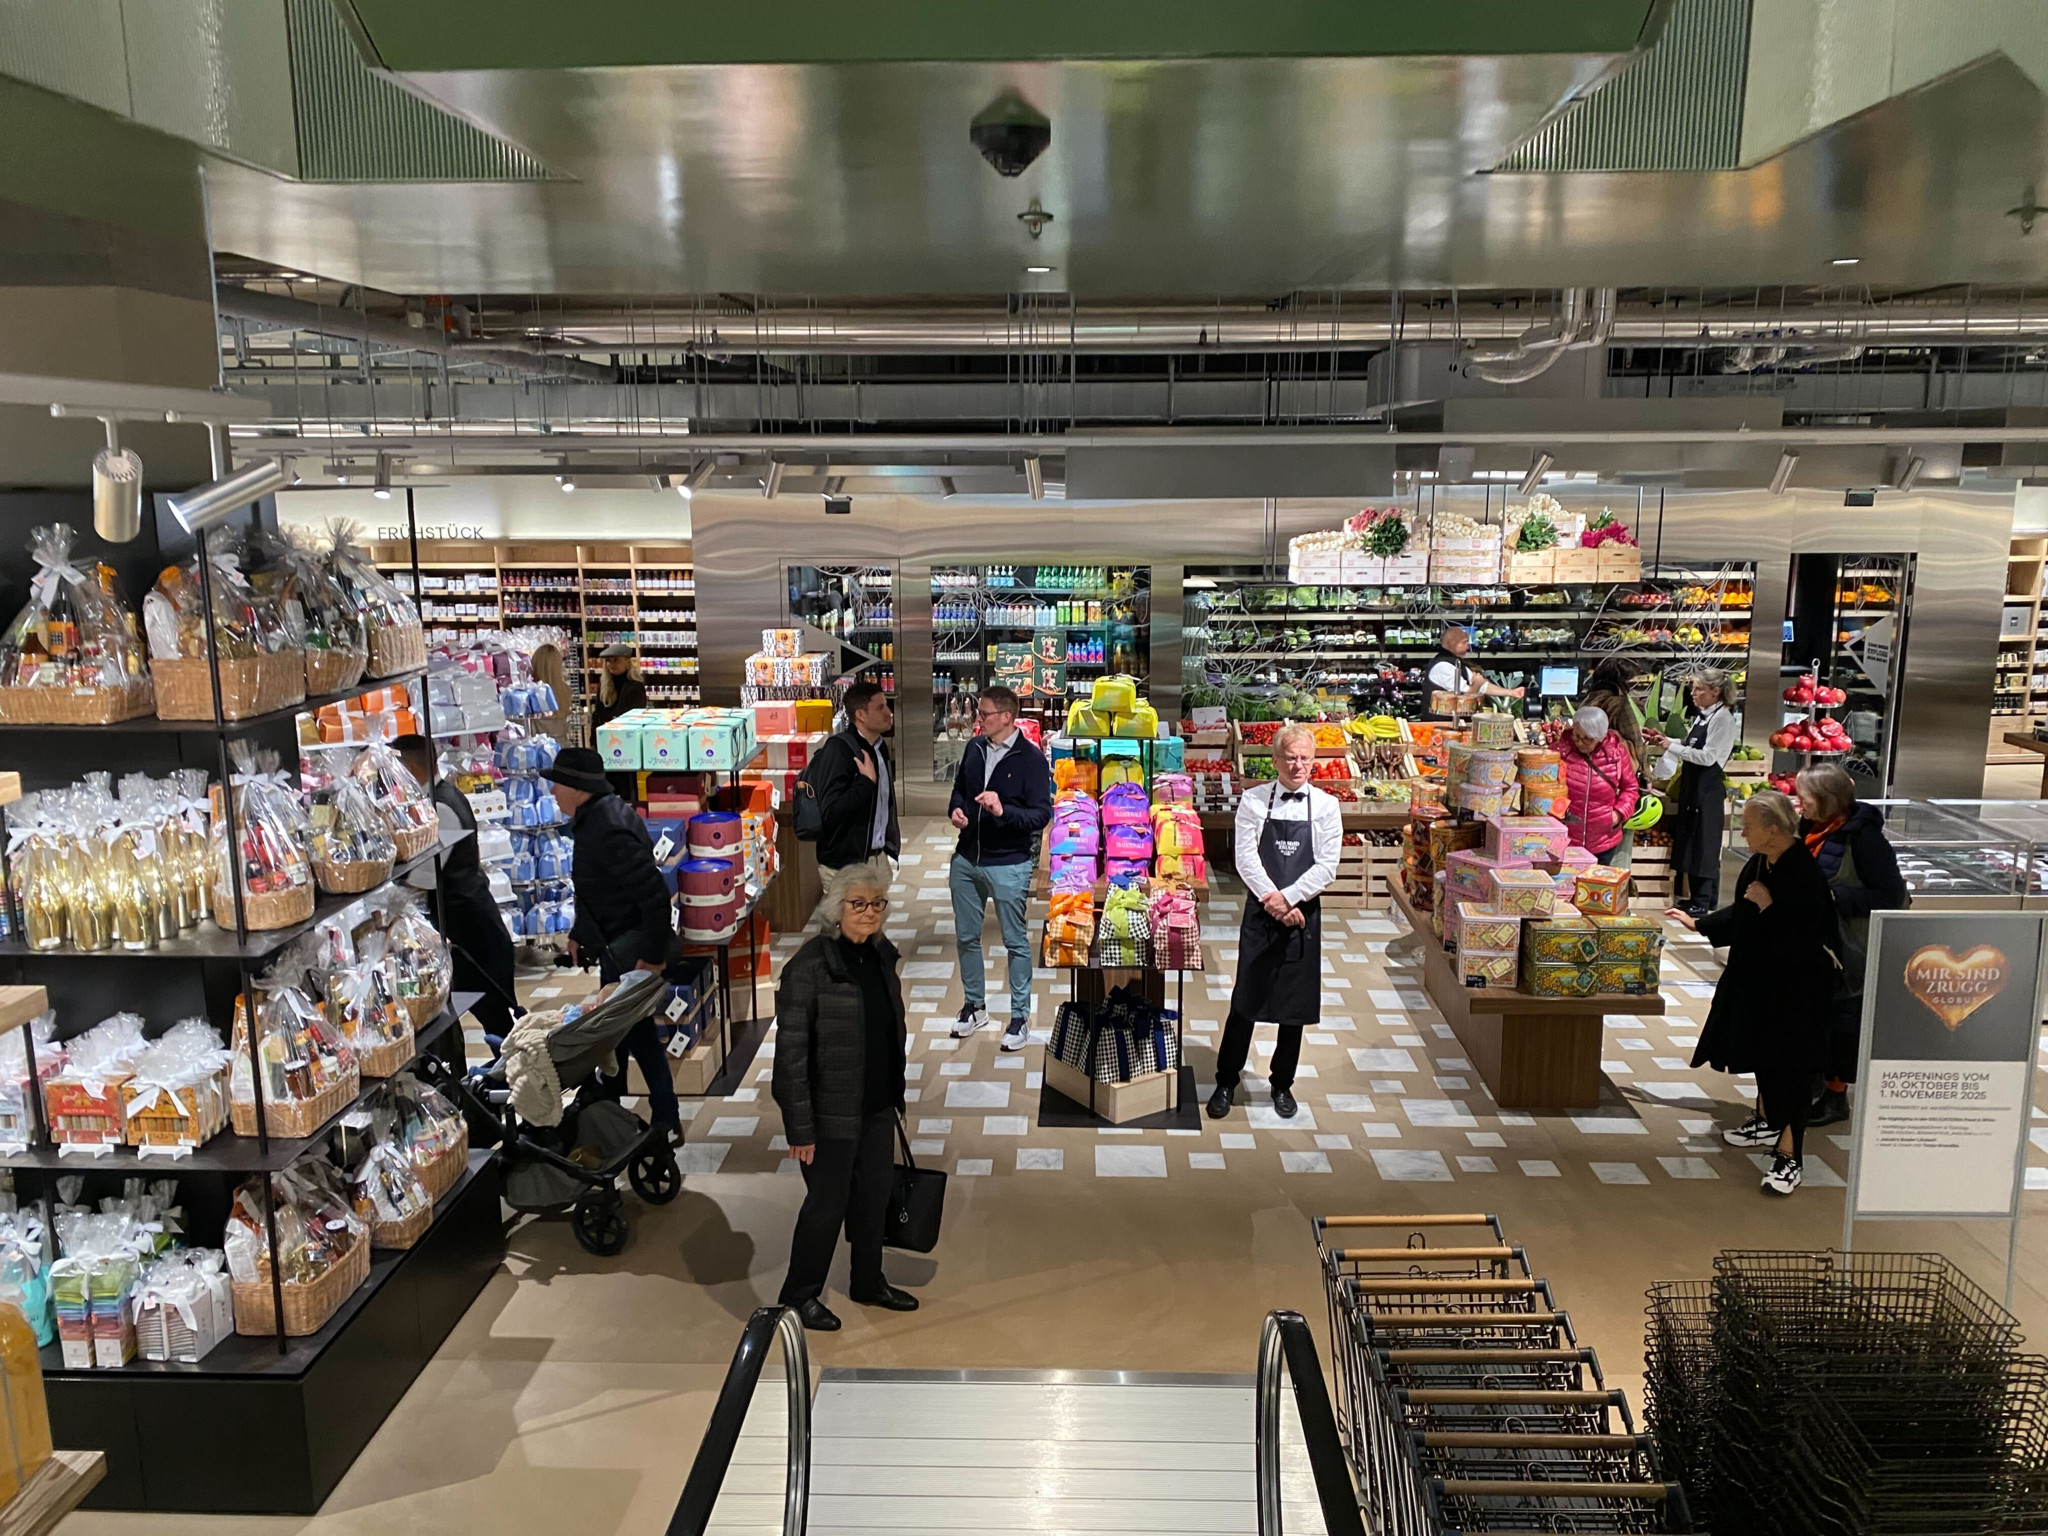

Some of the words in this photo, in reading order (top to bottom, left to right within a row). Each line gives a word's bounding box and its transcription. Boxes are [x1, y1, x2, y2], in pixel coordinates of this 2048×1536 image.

[377, 523, 484, 540] FRÜHSTÜCK
[1916, 967, 1951, 980] MIR
[1956, 967, 2000, 980] SIND
[1926, 981, 1988, 993] ZRUGG
[1932, 996, 1977, 1004] GLOBU
[1882, 1071, 1960, 1081] HAPPENINGS
[1962, 1072, 1990, 1081] VOM
[1880, 1080, 1898, 1089] 30.
[1901, 1080, 1958, 1090] OKTOBER
[1961, 1082, 1980, 1091] BIS
[1879, 1089, 1888, 1098] 1.
[1890, 1090, 1958, 1100] NOVEMBER
[1960, 1091, 1987, 1100] 2025
